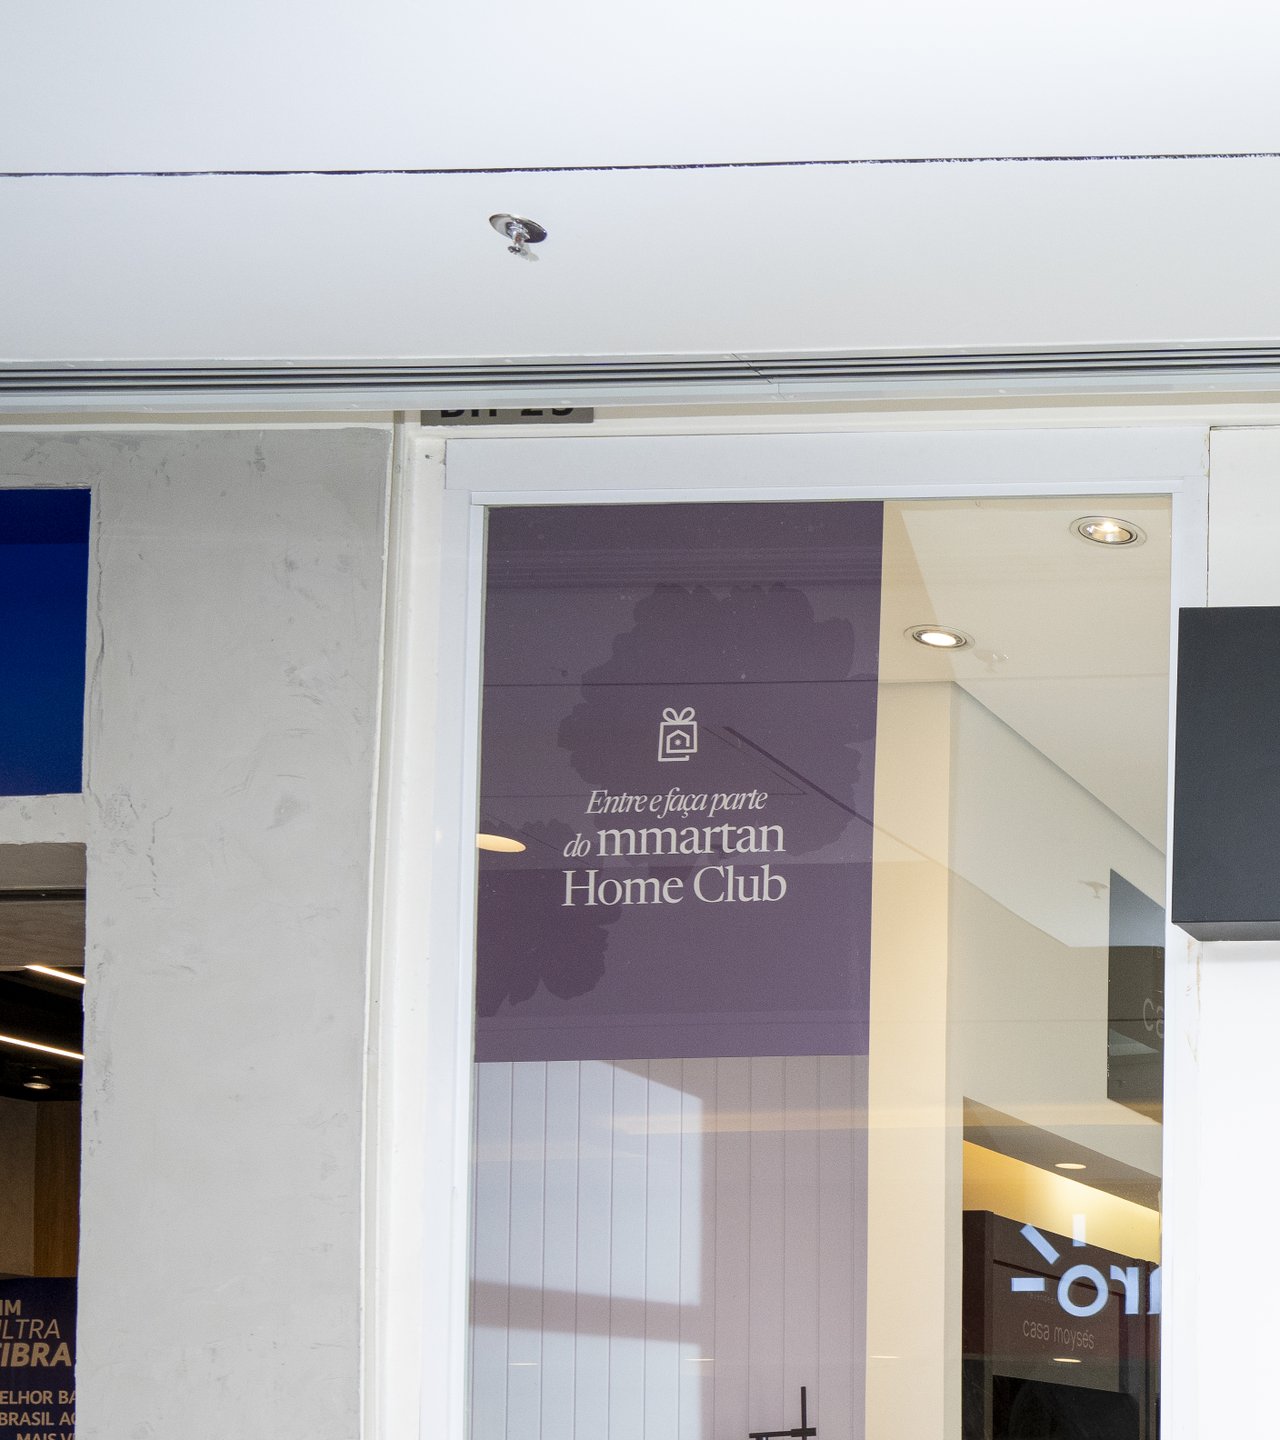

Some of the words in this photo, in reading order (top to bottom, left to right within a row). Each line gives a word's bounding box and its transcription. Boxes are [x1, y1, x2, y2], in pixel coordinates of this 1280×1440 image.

[584, 789, 648, 815] Entre
[649, 796, 663, 813] e
[656, 786, 707, 819] faça
[707, 789, 769, 818] parte
[563, 833, 592, 857] do
[596, 822, 787, 857] mmartan
[561, 868, 685, 907] Home
[693, 863, 788, 903] Club
[0, 1318, 61, 1340] LTRA
[1022, 1320, 1050, 1341] casa
[0, 1342, 73, 1367] IBRA
